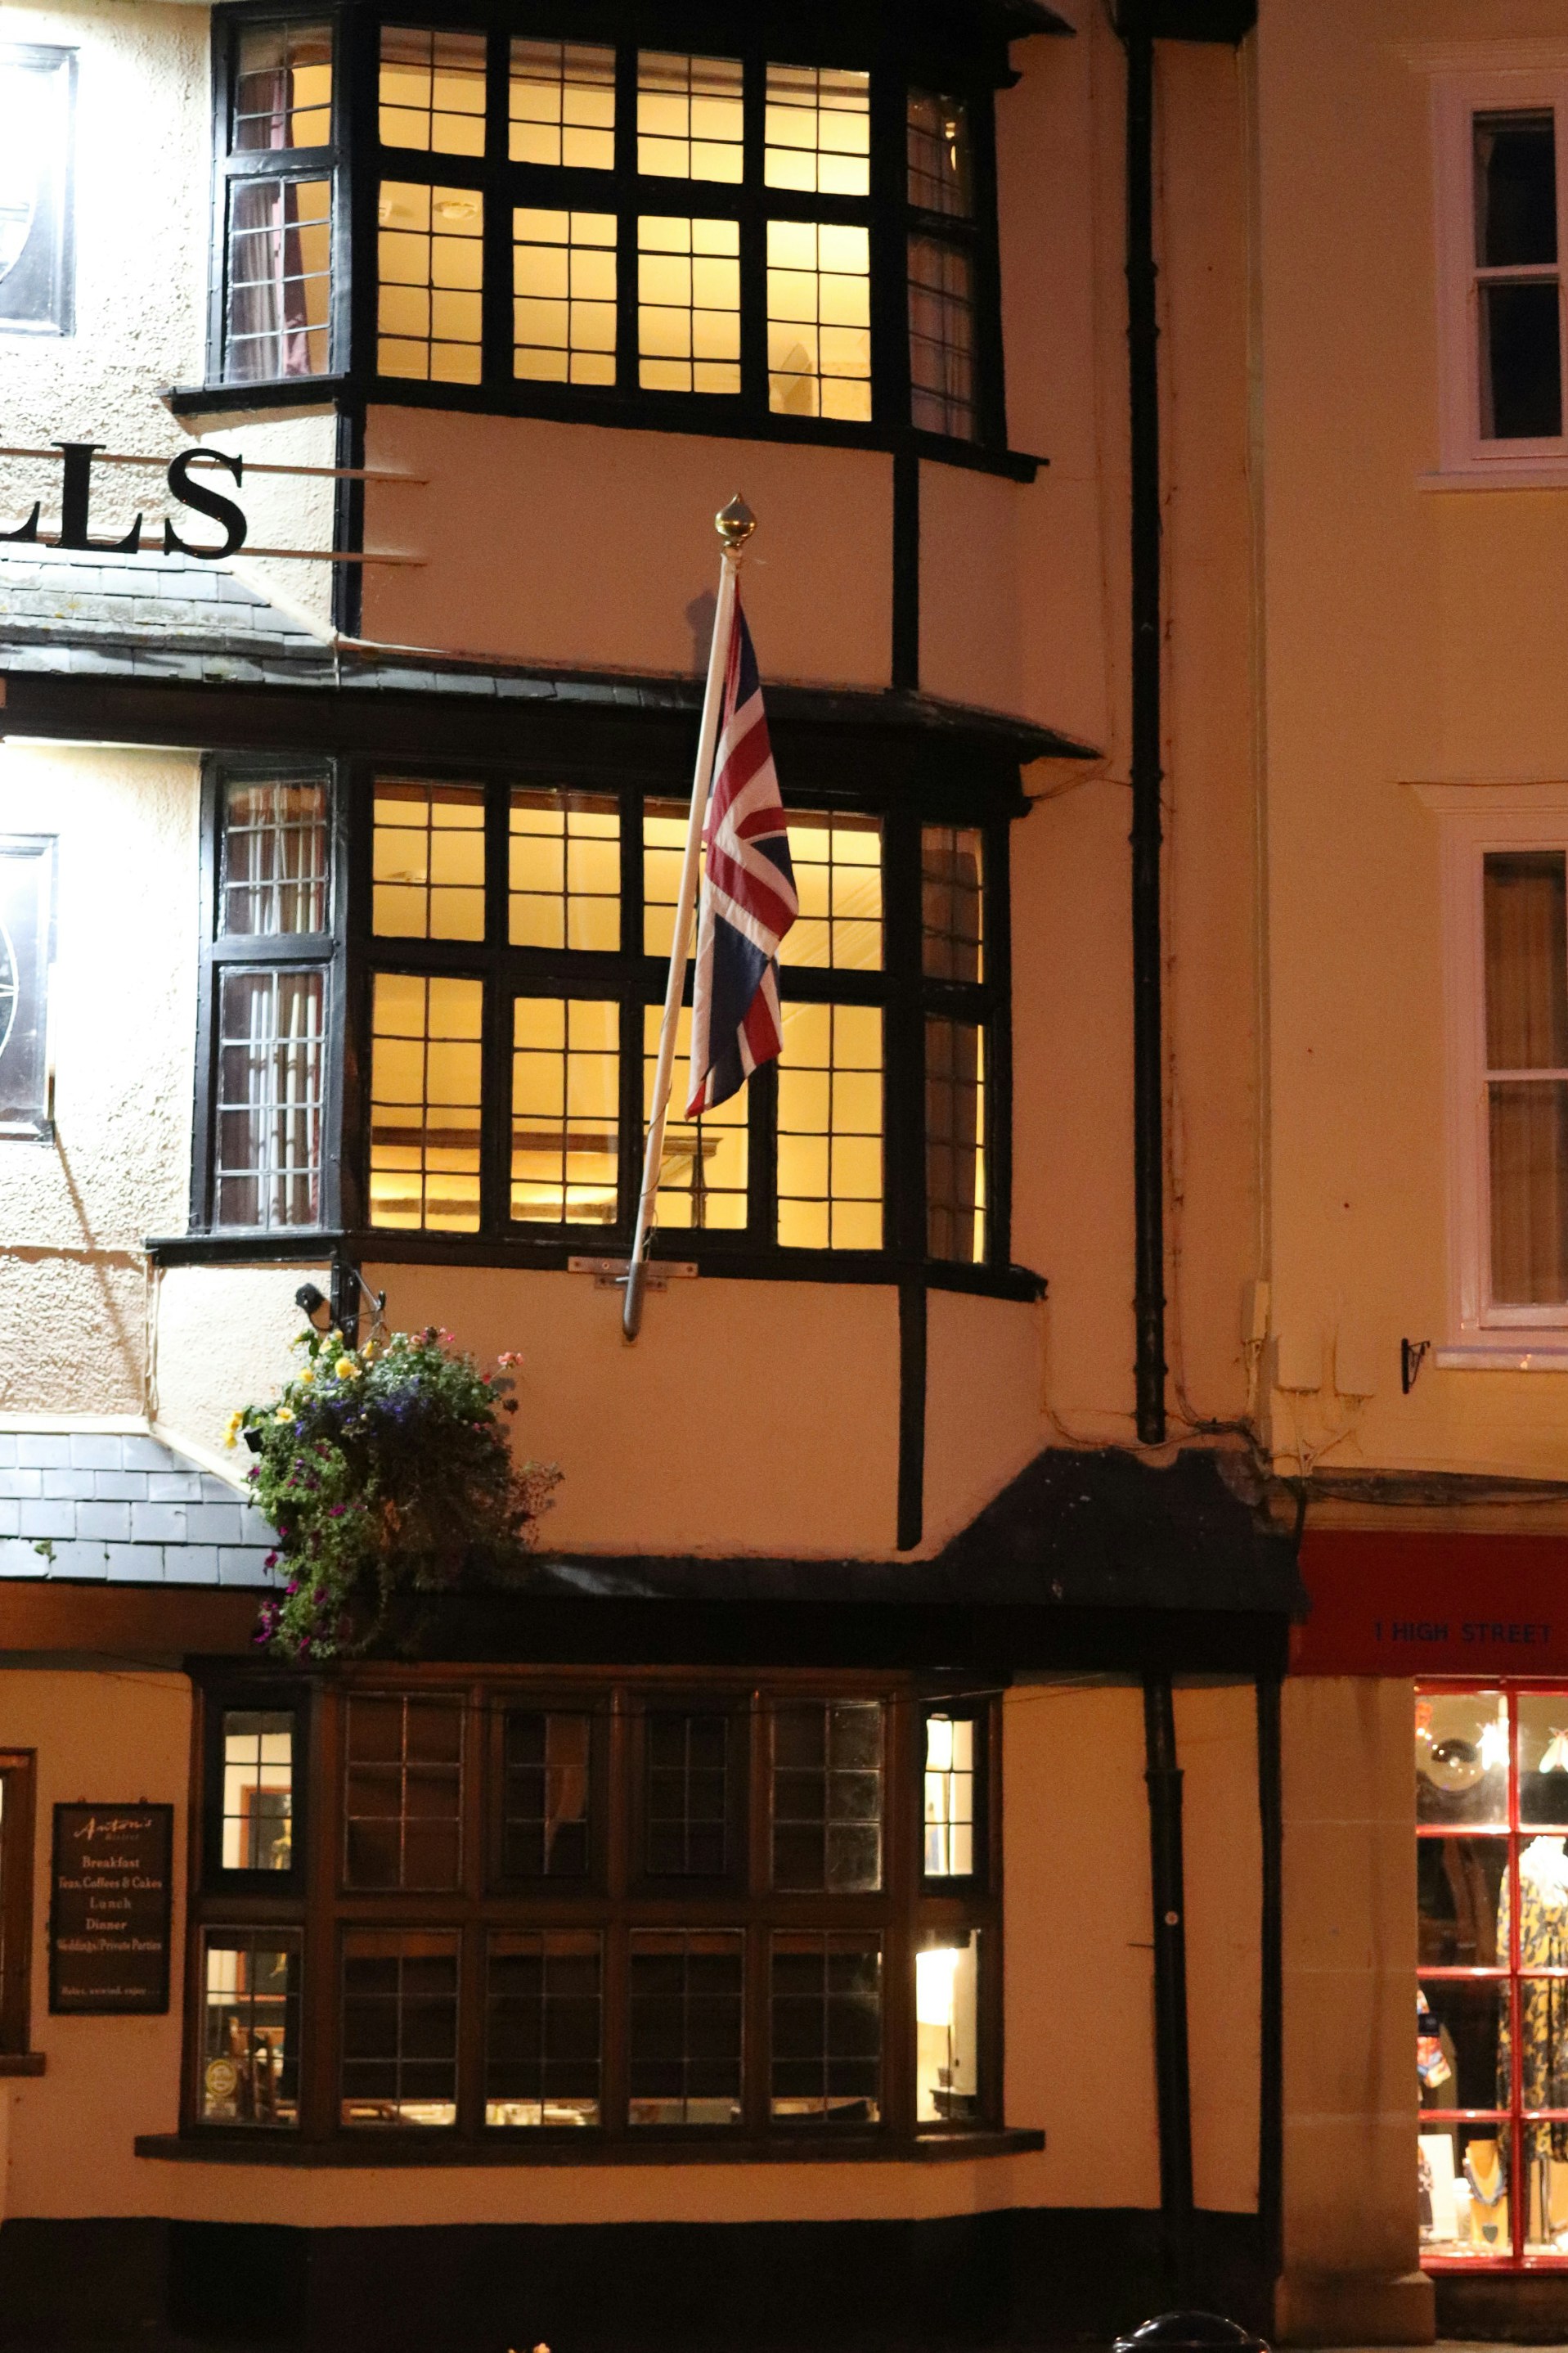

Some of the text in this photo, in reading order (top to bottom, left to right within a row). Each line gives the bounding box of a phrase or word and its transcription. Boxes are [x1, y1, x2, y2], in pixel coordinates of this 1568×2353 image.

[1392, 1622, 1449, 1642] HIGH
[1462, 1623, 1552, 1643] STREET
[82, 1855, 140, 1868] Breakfast
[83, 1875, 120, 1889] Coffees
[132, 1875, 163, 1889] Cakes
[89, 1896, 132, 1909] Lunch
[85, 1918, 128, 1930] Dinner
